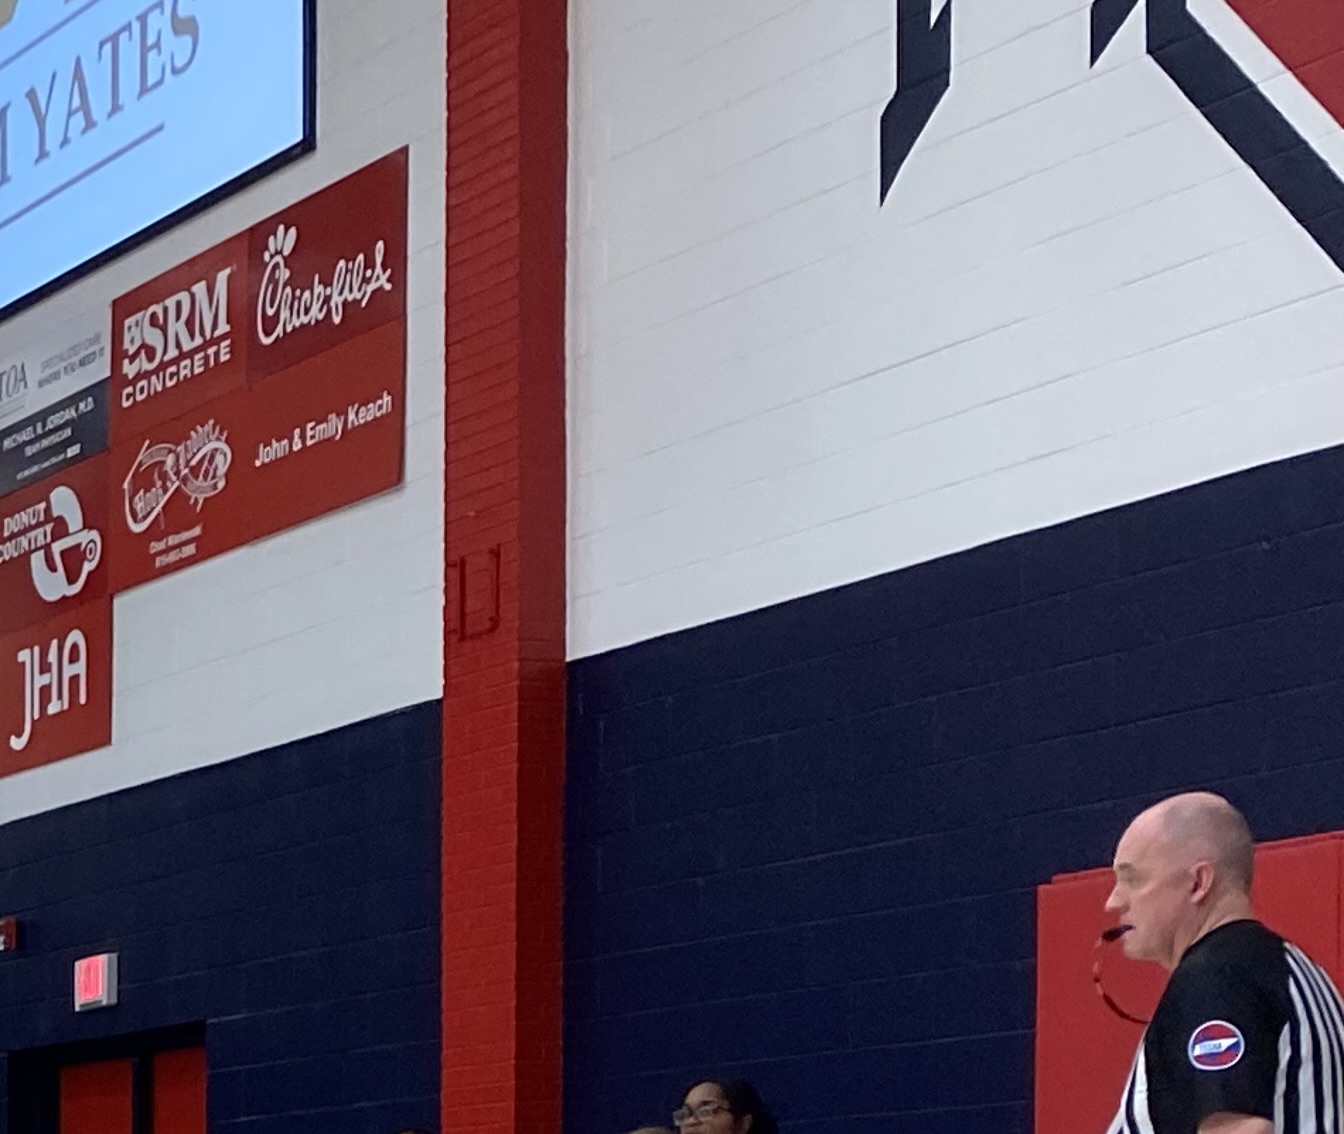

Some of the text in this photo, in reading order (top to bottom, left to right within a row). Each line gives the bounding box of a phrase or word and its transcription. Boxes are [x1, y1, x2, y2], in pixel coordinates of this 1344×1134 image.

[25, 0, 199, 166] YATES
[139, 266, 233, 374] SRM
[256, 236, 393, 346] Chick-fil-A
[120, 338, 233, 409] CONCRETE
[254, 437, 289, 468] John
[292, 429, 302, 451] &
[306, 412, 344, 449] Emily
[347, 390, 393, 426] Keach
[3, 500, 47, 538] DONUT
